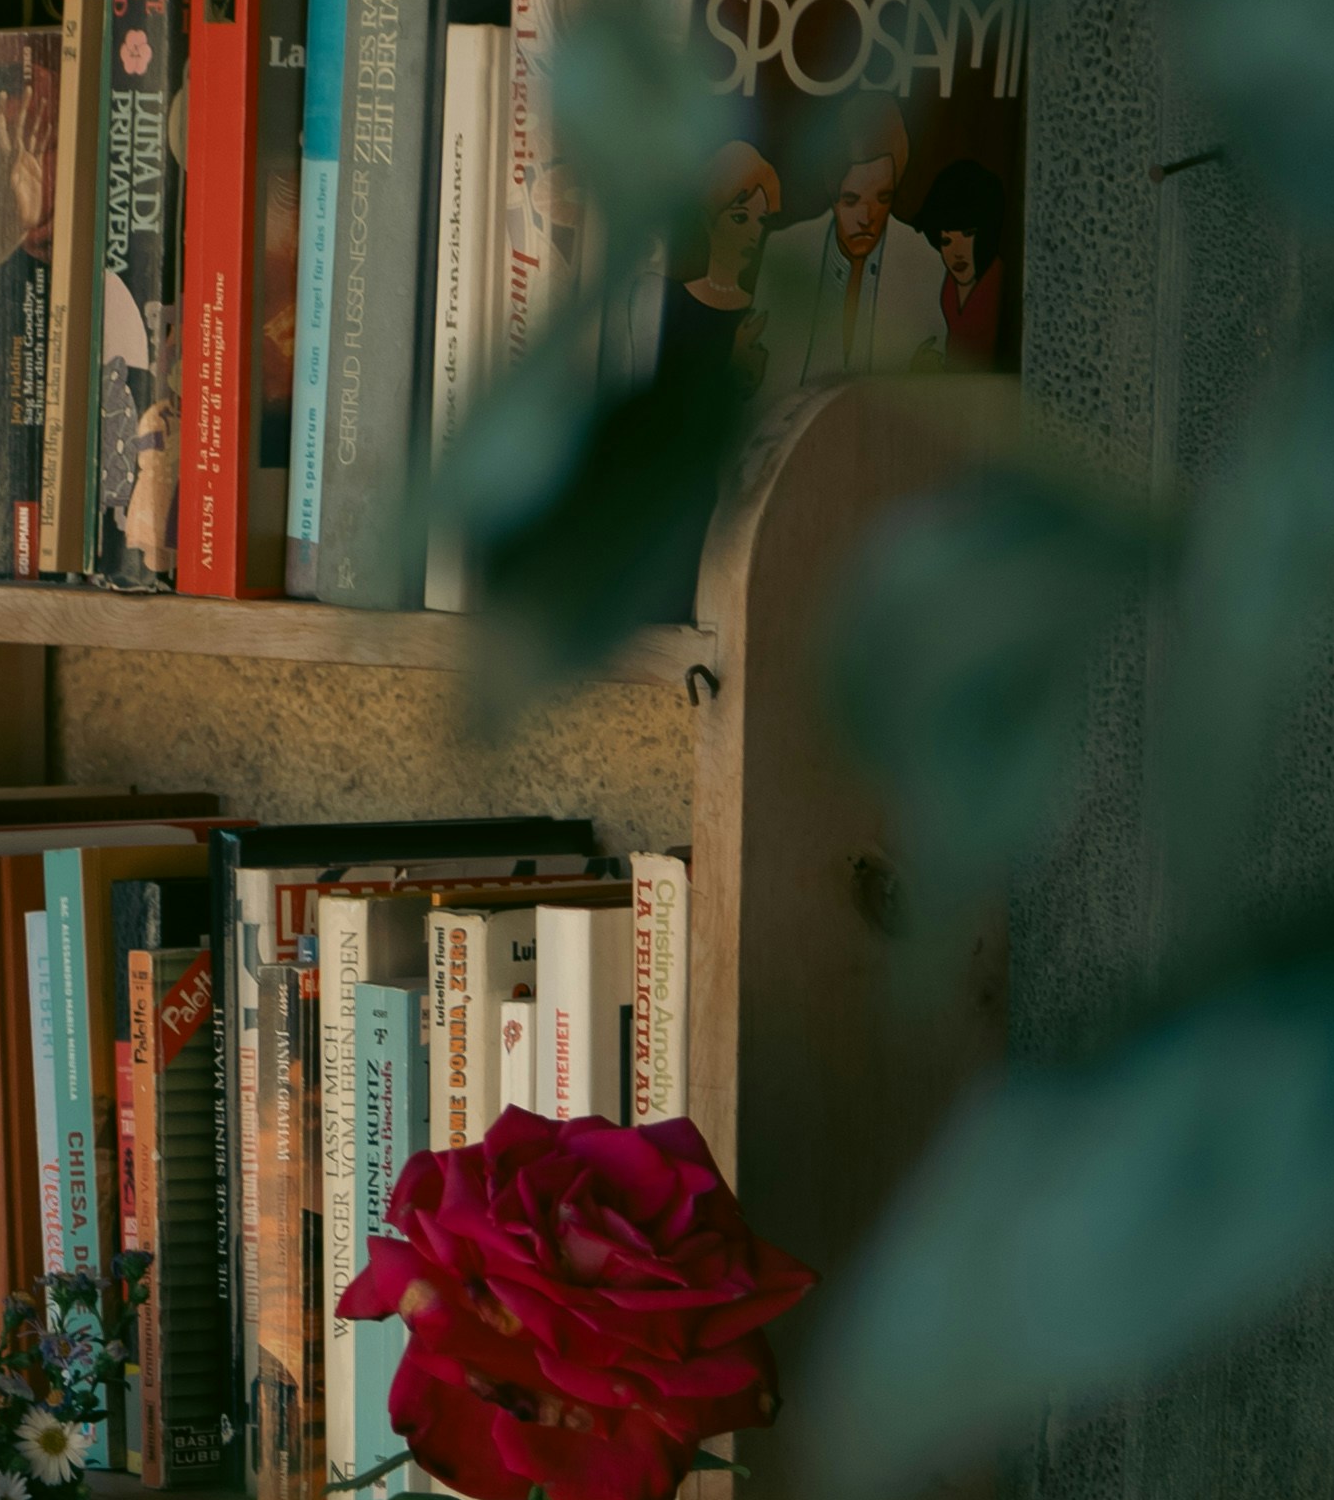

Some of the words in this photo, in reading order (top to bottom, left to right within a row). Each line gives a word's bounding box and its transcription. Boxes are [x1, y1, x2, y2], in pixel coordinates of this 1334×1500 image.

[357, 42, 375, 90] DES
[377, 31, 398, 92] DER
[353, 103, 372, 164] ZEIT
[372, 103, 394, 166] ZEIT
[105, 90, 135, 274] PRIMAVERA
[317, 172, 328, 220] Leben
[313, 258, 324, 282] für
[315, 226, 326, 253] das
[345, 169, 371, 350] FUSSENEGGER
[35, 267, 45, 294] um
[213, 272, 225, 313] bene
[311, 284, 323, 330] Engel
[23, 281, 37, 348] Goodbye
[34, 297, 45, 339] nicht
[202, 303, 211, 358] cucina
[11, 336, 24, 398] Fielding
[202, 363, 210, 380] in
[212, 316, 226, 388] mangiar
[10, 402, 23, 424] Joy
[199, 385, 210, 444] scienza
[211, 393, 222, 409] di
[338, 355, 362, 466] GERTRUD
[197, 449, 209, 471] La
[306, 407, 317, 490] spektrum
[200, 495, 215, 571] ARTUSI
[636, 878, 653, 918] LA
[434, 925, 445, 967] Fiumi
[449, 927, 468, 992] ZERO
[653, 878, 677, 1003] Christine
[340, 930, 359, 1019] REDEN
[435, 969, 446, 1027] Luisella
[213, 1003, 225, 1091] MACHT
[275, 1029, 290, 1087] JANICE
[324, 1024, 340, 1097] MICH
[449, 994, 473, 1089] DONNA,
[556, 1007, 571, 1101] FREIHEIT
[651, 1004, 676, 1114] Arnothy
[276, 1088, 290, 1162] GRAHAM
[368, 1059, 381, 1140] KURTZ
[381, 1059, 393, 1141] Bischofs
[324, 1105, 340, 1179] LASST
[67, 1130, 89, 1237] CHIESA,
